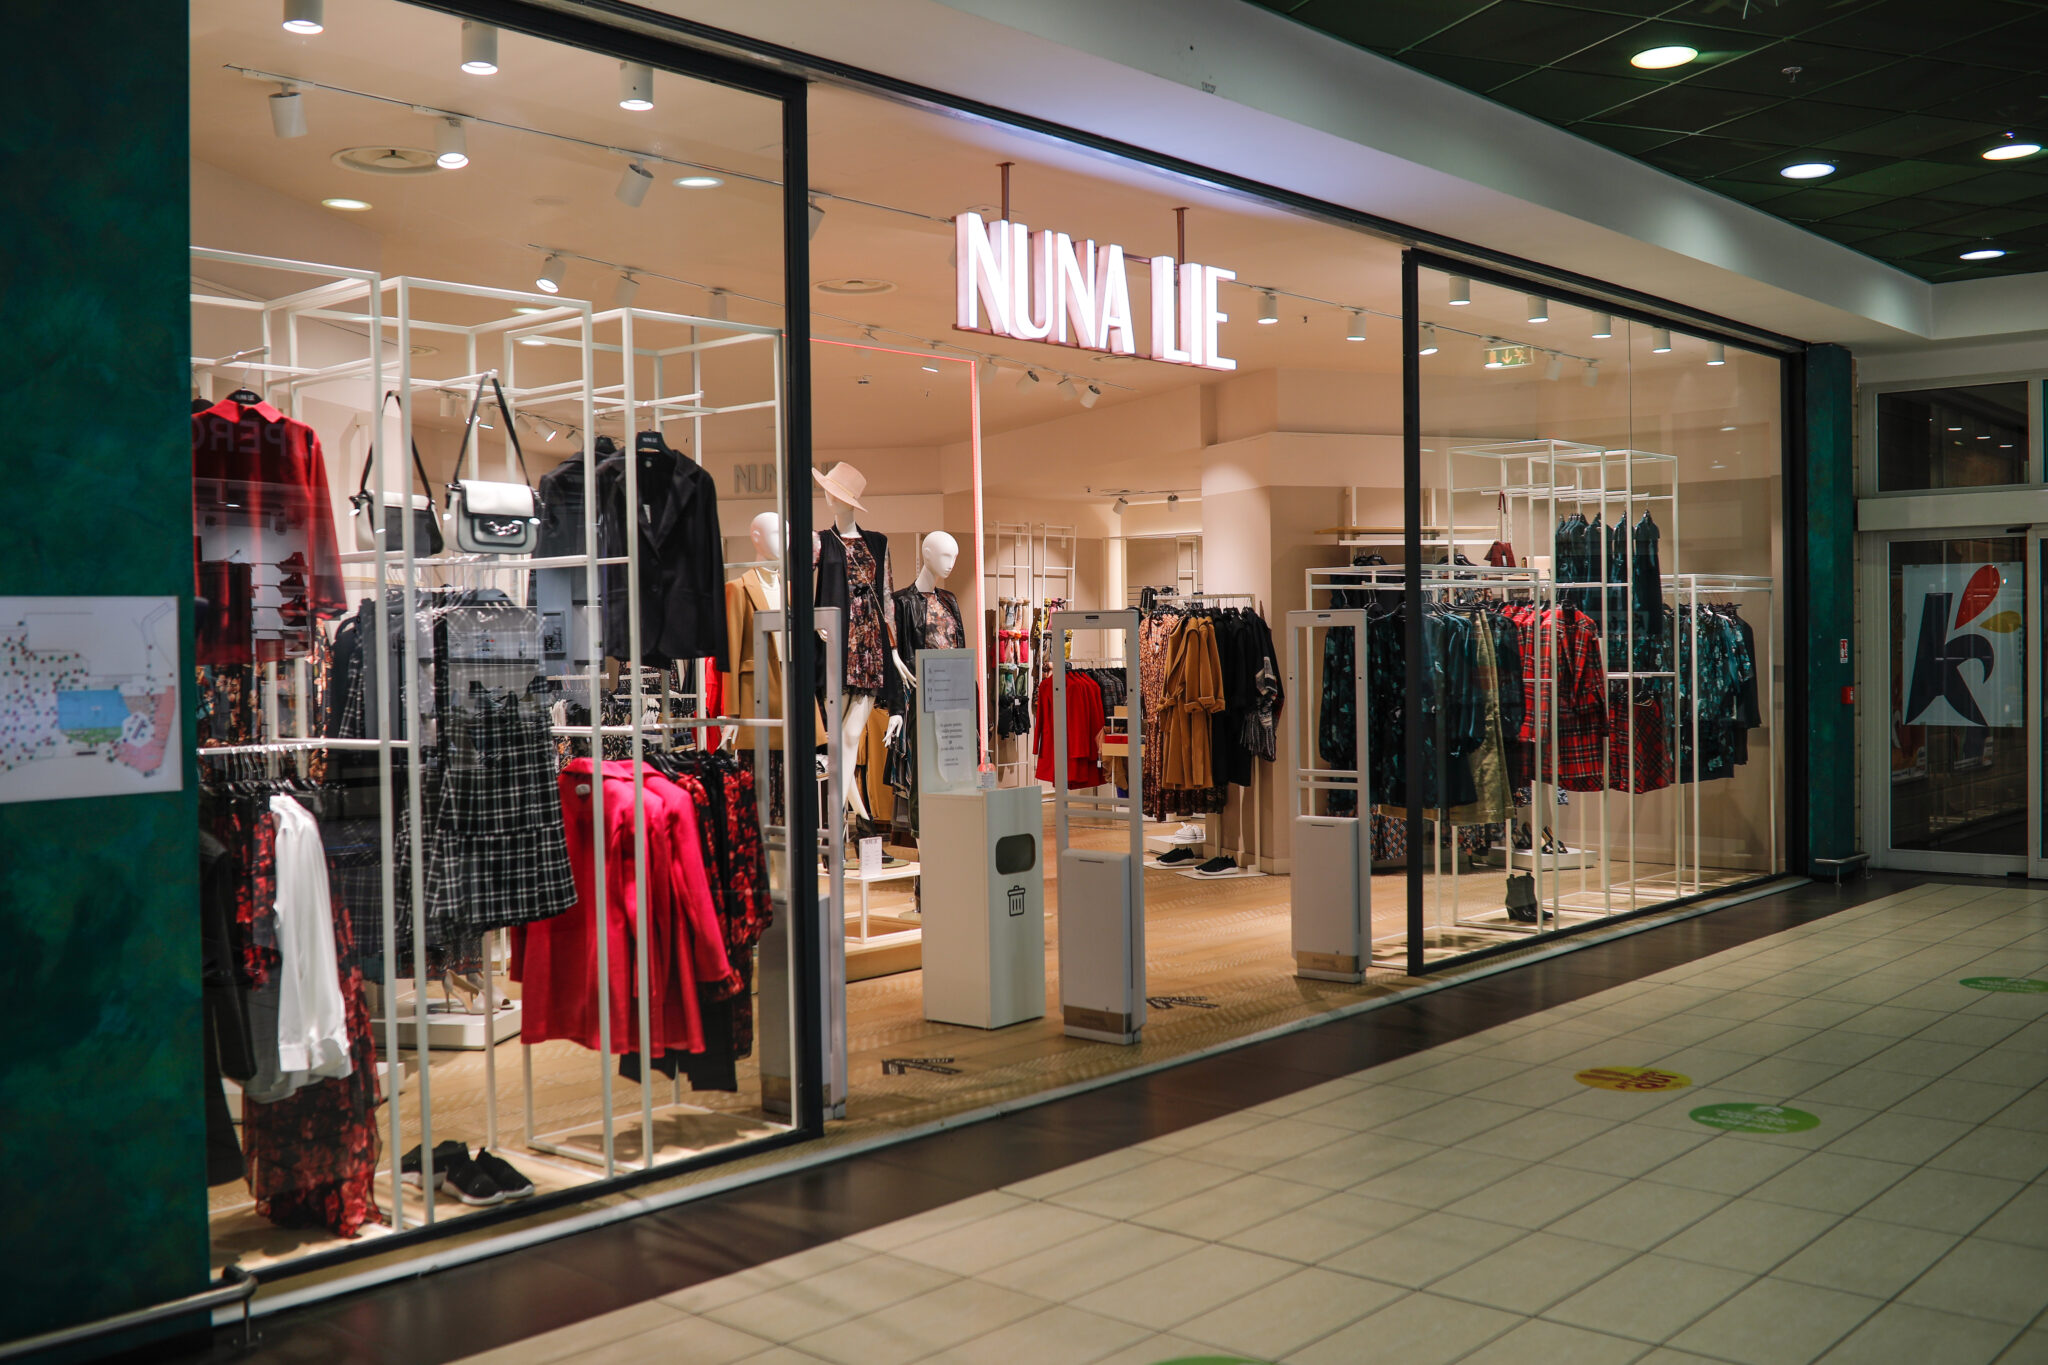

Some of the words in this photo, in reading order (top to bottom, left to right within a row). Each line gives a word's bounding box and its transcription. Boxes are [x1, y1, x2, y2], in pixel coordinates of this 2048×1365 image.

[957, 211, 1136, 354] NUNA
[1151, 255, 1237, 371] LIE
[733, 463, 777, 494] NUN
